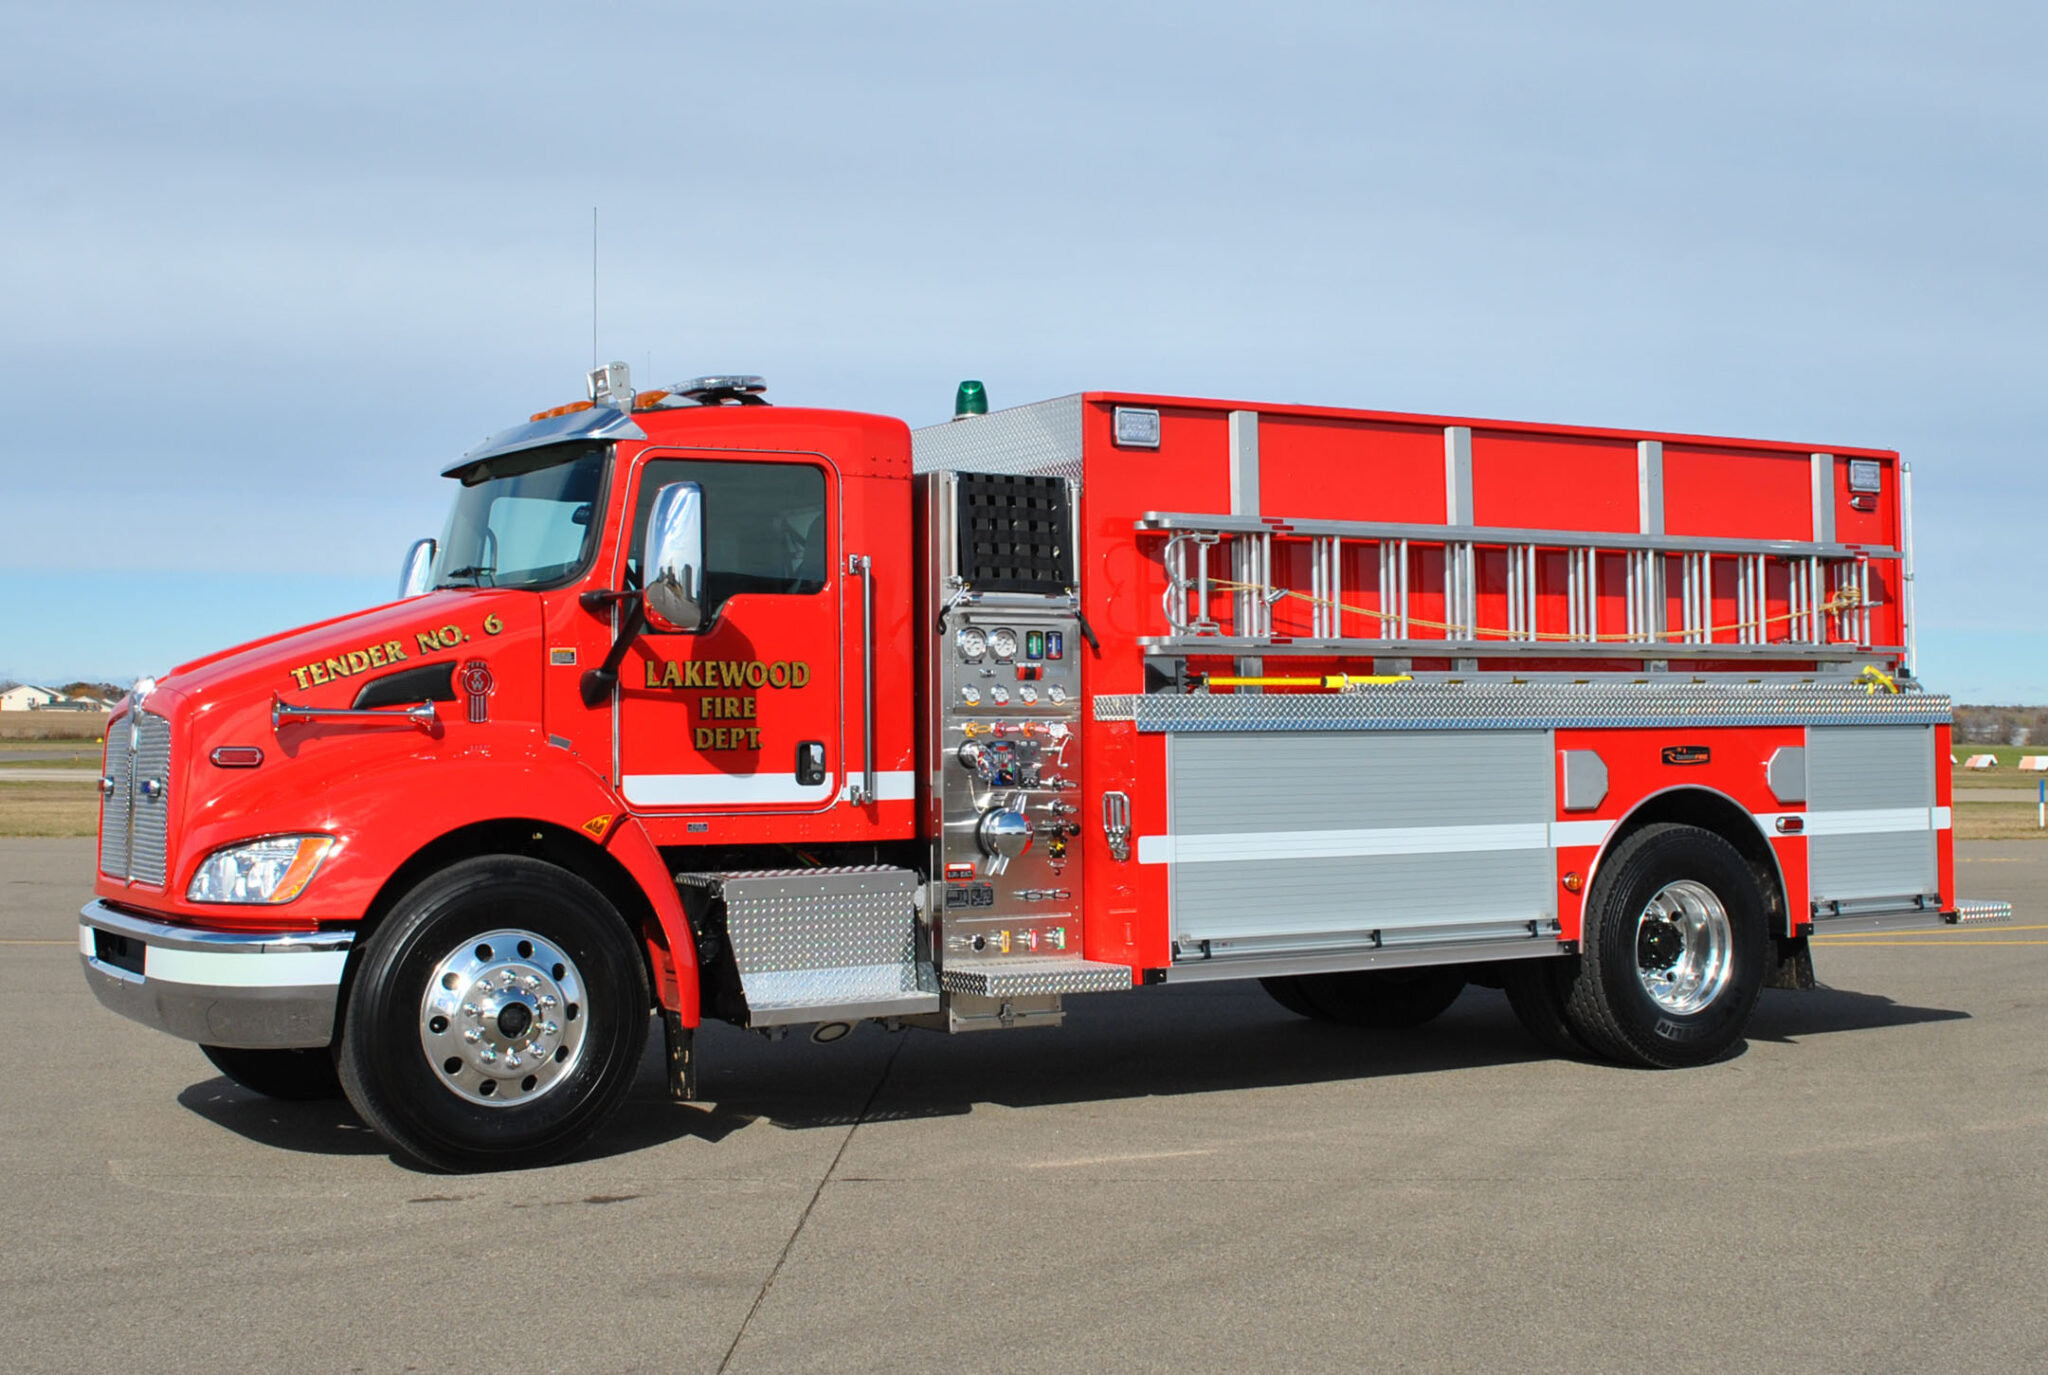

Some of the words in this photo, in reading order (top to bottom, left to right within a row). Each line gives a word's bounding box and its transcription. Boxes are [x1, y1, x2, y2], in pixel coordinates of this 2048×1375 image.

[290, 640, 408, 691] TENDER
[415, 624, 470, 655] NO.
[483, 613, 503, 635] 6
[645, 660, 811, 689] LAKEWOOD
[700, 697, 757, 720] FIRE
[694, 727, 764, 750] DEPT.
